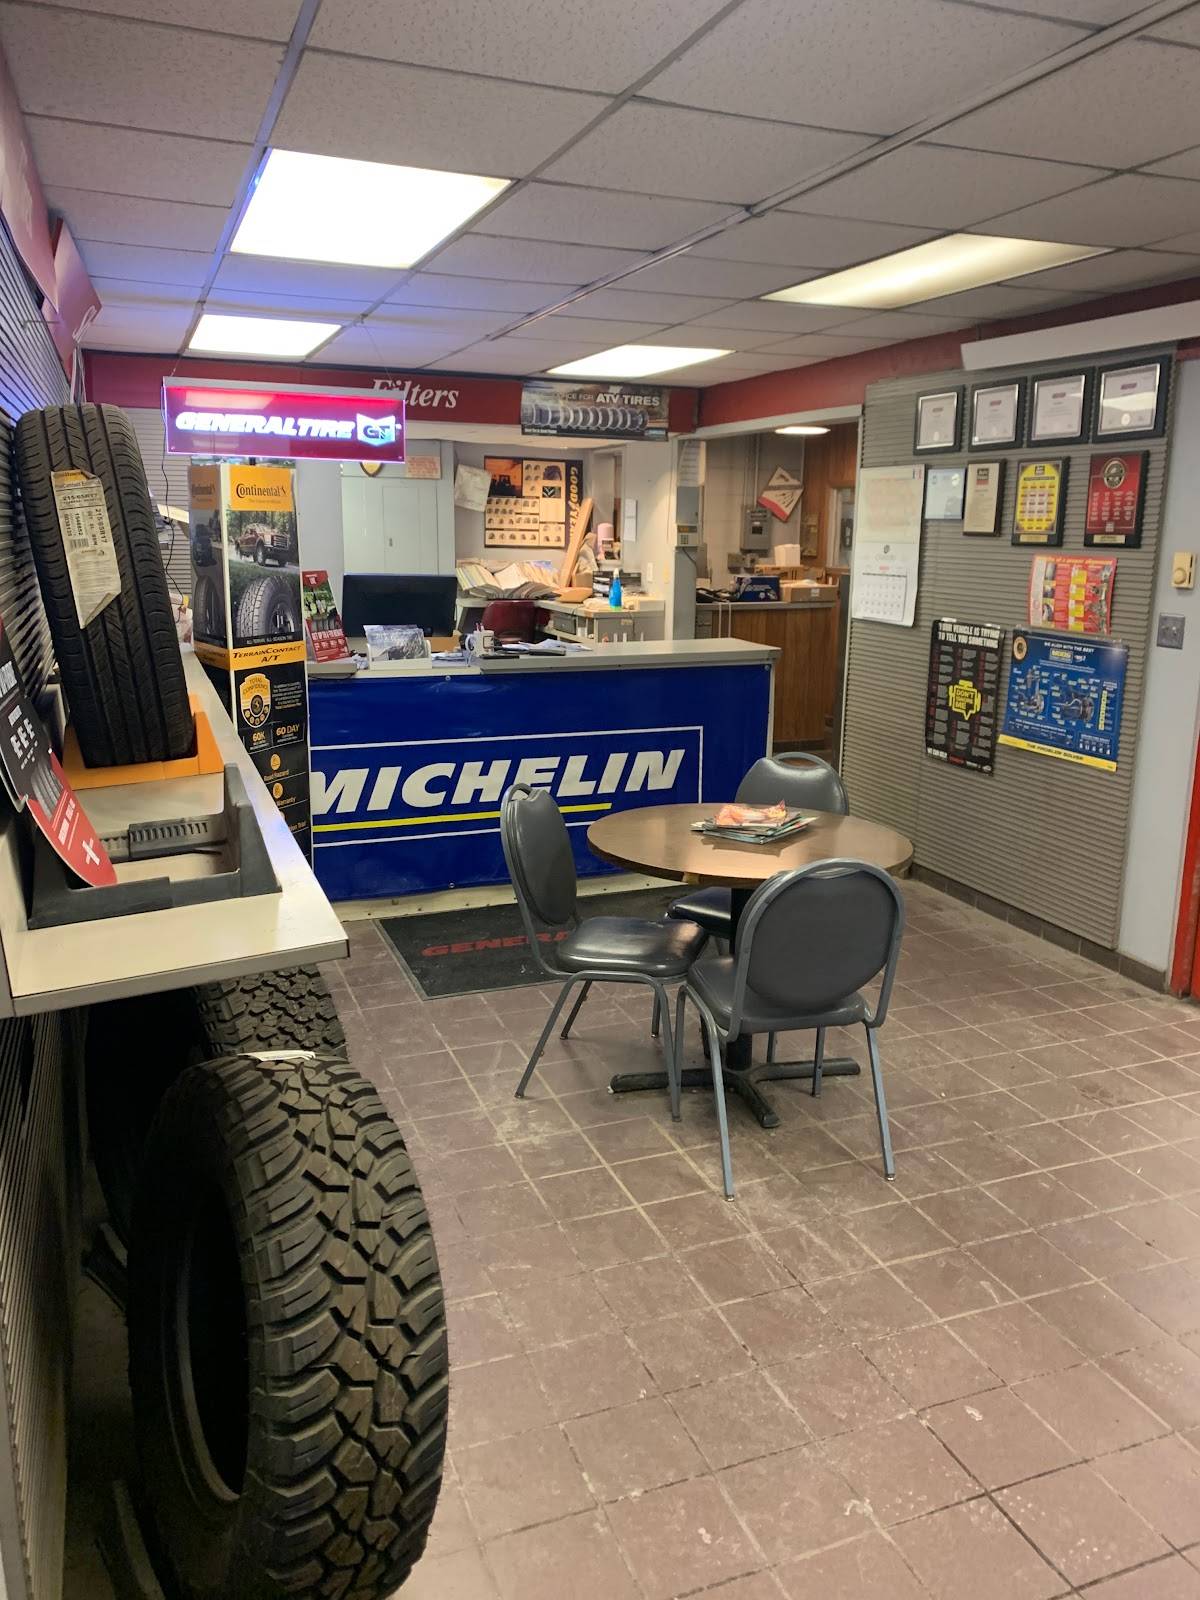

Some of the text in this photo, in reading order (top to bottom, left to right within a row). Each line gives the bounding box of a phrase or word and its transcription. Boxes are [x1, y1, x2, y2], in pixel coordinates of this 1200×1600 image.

[596, 393, 622, 403] ATV
[623, 394, 660, 406] TIRES
[236, 483, 281, 499] Continental
[953, 624, 973, 635] VEHICLE
[973, 626, 980, 636] IS
[981, 628, 1000, 639] TRYING
[938, 631, 999, 649] TO TELL YOU SOMETHING
[261, 654, 280, 663] A/T
[956, 689, 974, 699] DON'T
[276, 724, 299, 736] 60 DAY
[311, 749, 685, 817] MICHELIN
[422, 930, 569, 957] GENERA
